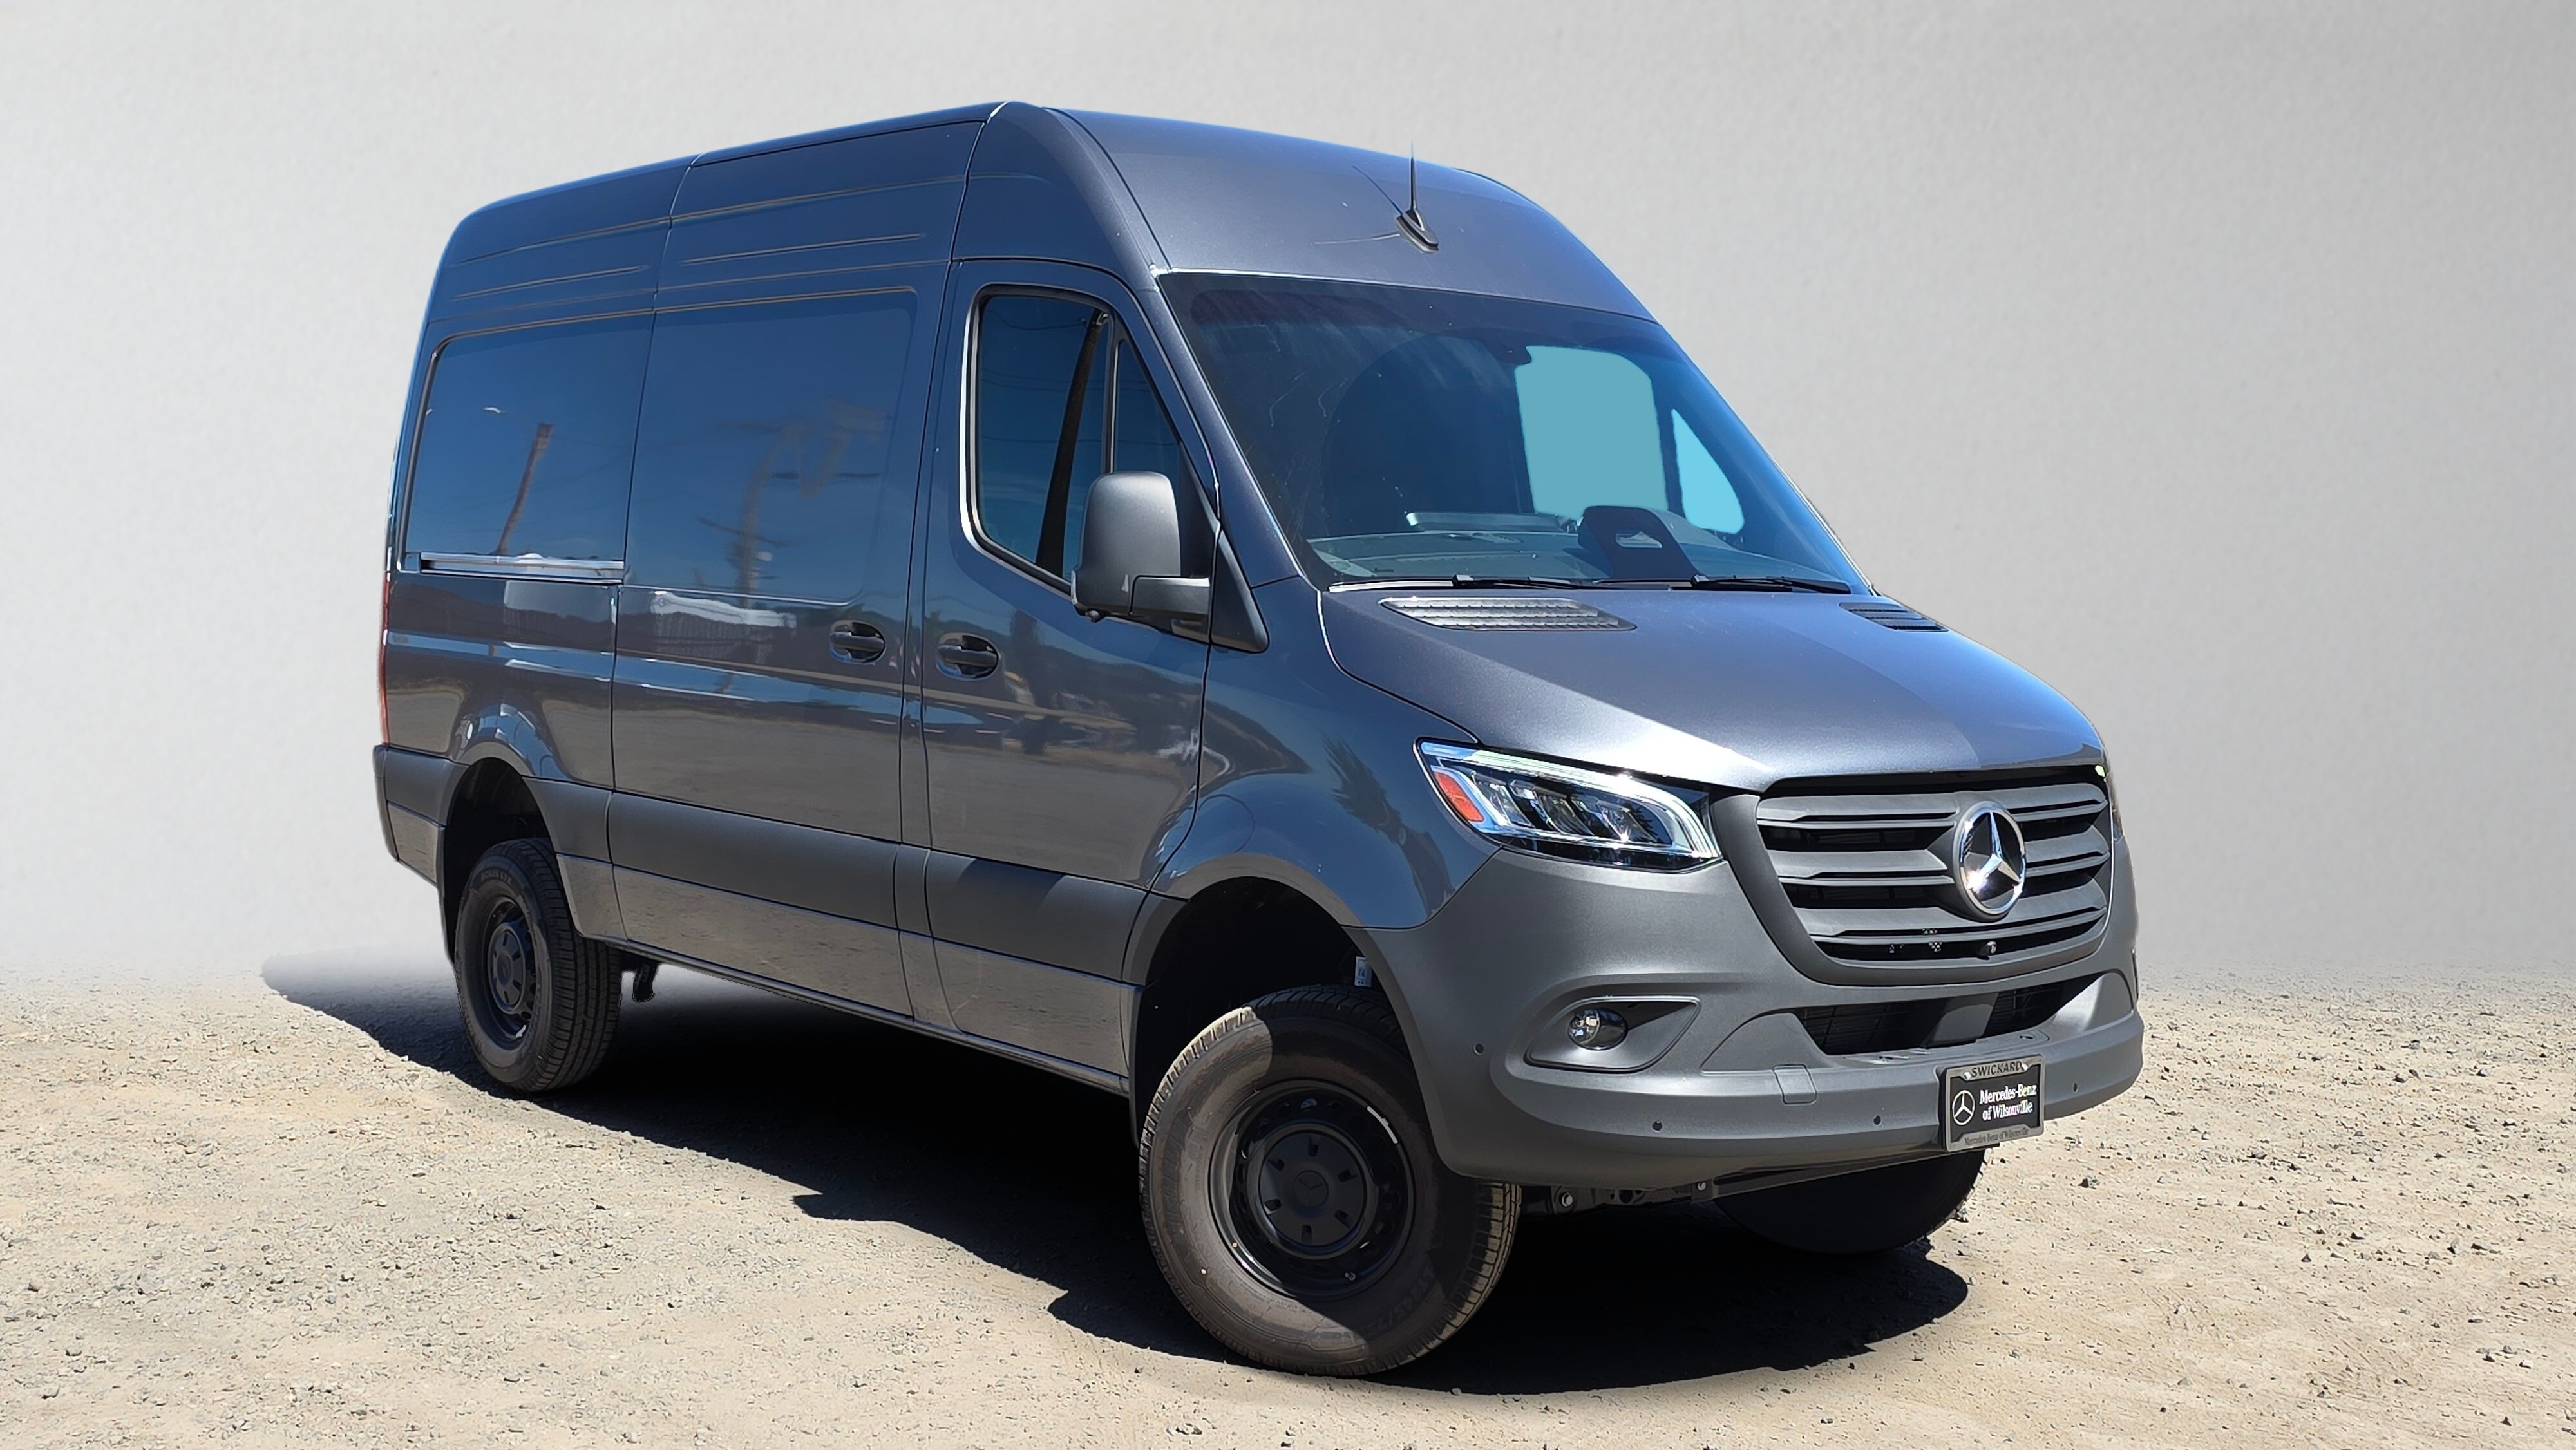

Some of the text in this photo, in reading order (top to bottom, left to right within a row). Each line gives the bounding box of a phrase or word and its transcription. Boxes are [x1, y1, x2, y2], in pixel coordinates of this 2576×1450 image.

[1971, 1061, 2023, 1078] SWICKARD
[1979, 1084, 2037, 1105] Mercedes-Benz
[1982, 1099, 2033, 1121] of Wilsonville
